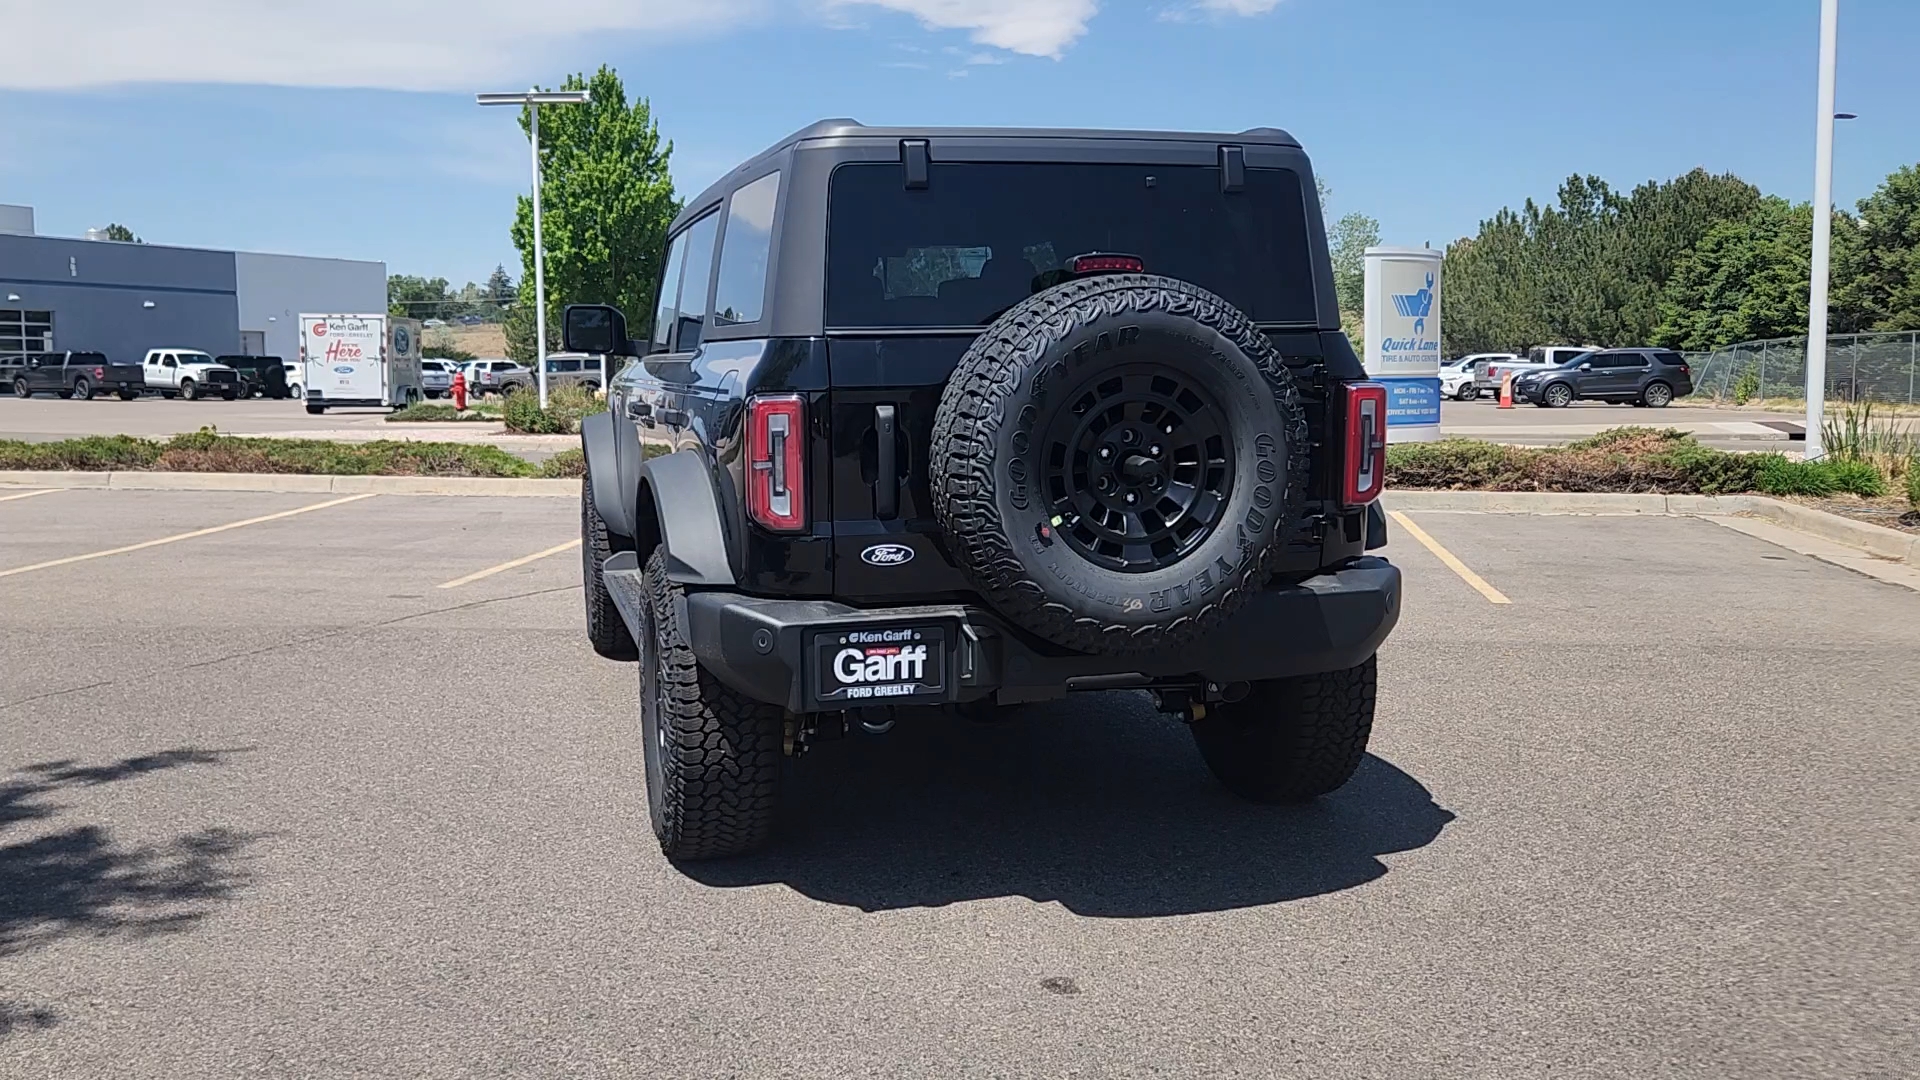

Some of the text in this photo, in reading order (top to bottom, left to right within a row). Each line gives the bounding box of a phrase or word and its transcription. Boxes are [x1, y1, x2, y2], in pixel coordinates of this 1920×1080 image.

[330, 323, 368, 331] Ken Garff
[325, 339, 363, 364] Here
[1381, 338, 1438, 352] Quick Lane
[1382, 354, 1398, 362] TIRE
[1404, 354, 1420, 362] AUTO
[1149, 432, 1277, 612] GOODYEAR
[859, 629, 912, 643] Ken Garff
[833, 645, 927, 684] Garff
[847, 684, 915, 699] FORD GREELEY
